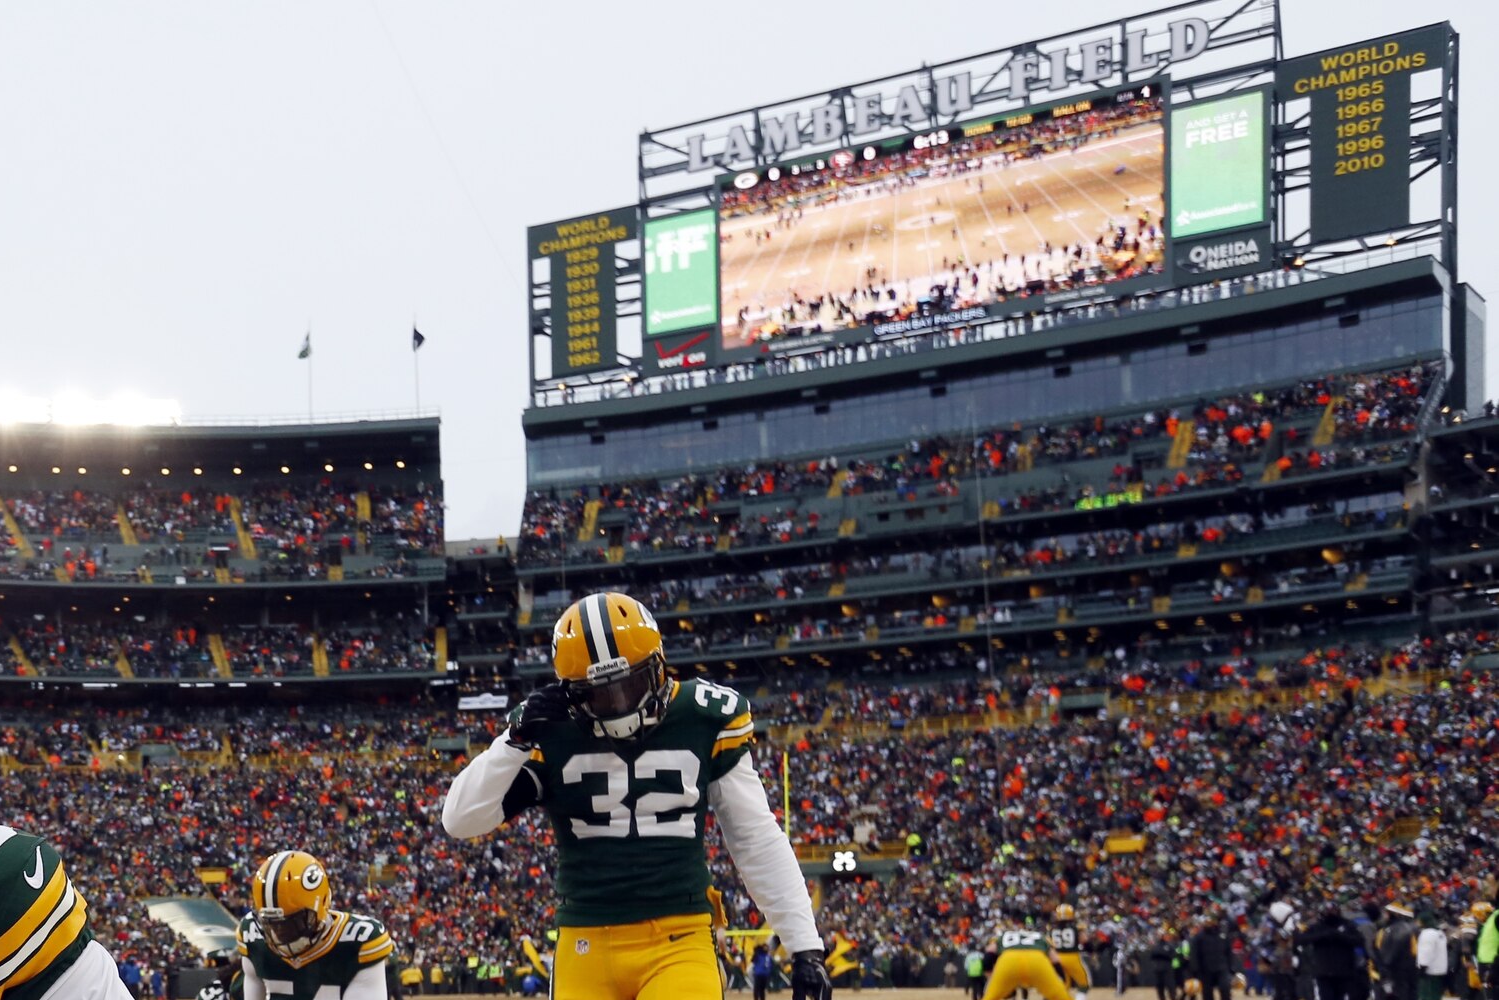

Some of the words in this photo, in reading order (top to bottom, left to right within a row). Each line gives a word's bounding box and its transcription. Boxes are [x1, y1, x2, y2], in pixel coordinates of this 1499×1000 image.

[1320, 42, 1399, 71] WORLD
[1294, 52, 1427, 93] CHAMPIONS
[686, 71, 973, 173] LAMBEAU
[1008, 17, 1210, 100] FIELD
[1335, 80, 1385, 102] 1965
[1185, 117, 1211, 129] AND
[1238, 109, 1248, 118] A
[1335, 99, 1385, 120] 1966
[1185, 120, 1248, 148] FREE
[1335, 117, 1383, 138] 1967
[1335, 136, 1385, 156] 1996
[1334, 153, 1385, 176] 2010
[556, 215, 610, 238] WORLD
[538, 226, 627, 254] CHAMPIONS
[1189, 238, 1259, 263] ONEIDA
[566, 262, 600, 278] 1930
[1206, 252, 1260, 270] NATION
[566, 277, 597, 293] 1931
[595, 661, 619, 674] Riddell
[562, 750, 701, 839] 32
